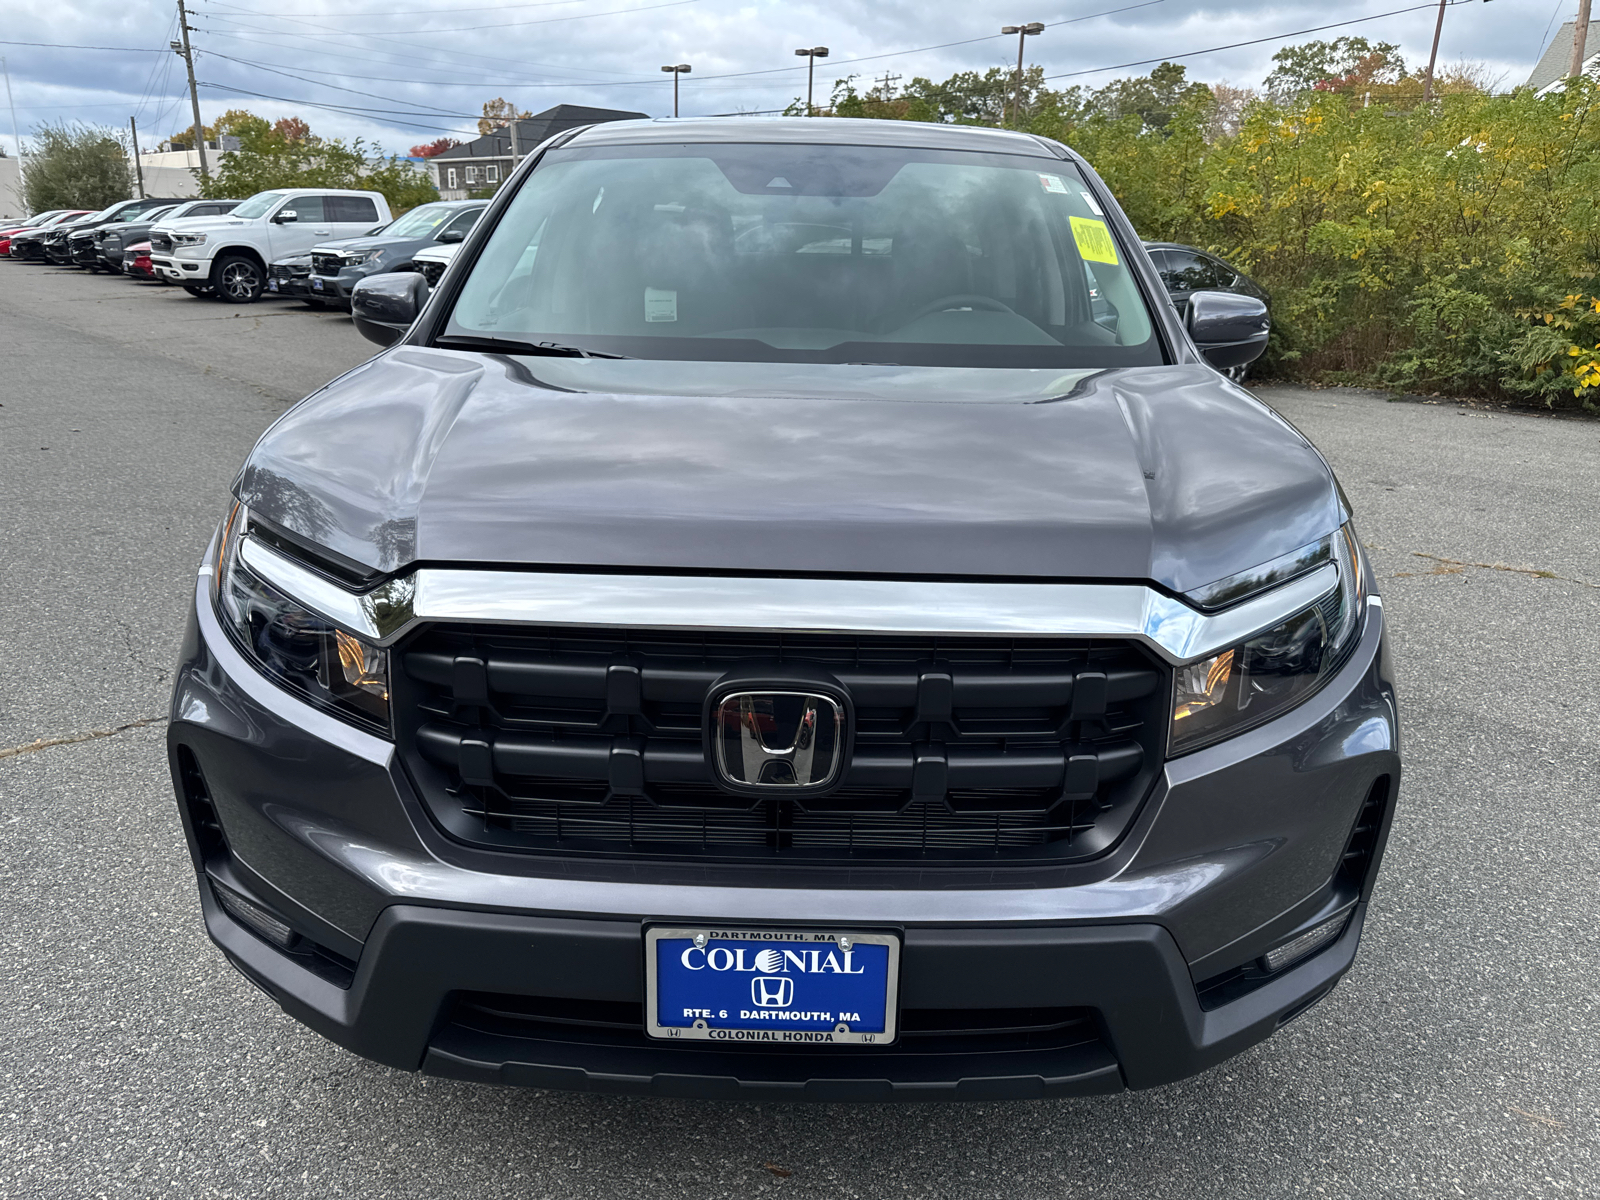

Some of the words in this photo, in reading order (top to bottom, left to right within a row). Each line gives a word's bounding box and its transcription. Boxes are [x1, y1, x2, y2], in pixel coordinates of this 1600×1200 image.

[681, 947, 864, 974] COLONIAL
[683, 1008, 715, 1018] RTE.
[719, 1009, 728, 1018] 6
[740, 1010, 835, 1022] DARTMOUTH,
[839, 1012, 861, 1021] MA
[708, 1030, 778, 1040] COLONIAL
[783, 1032, 833, 1042] HONDA
